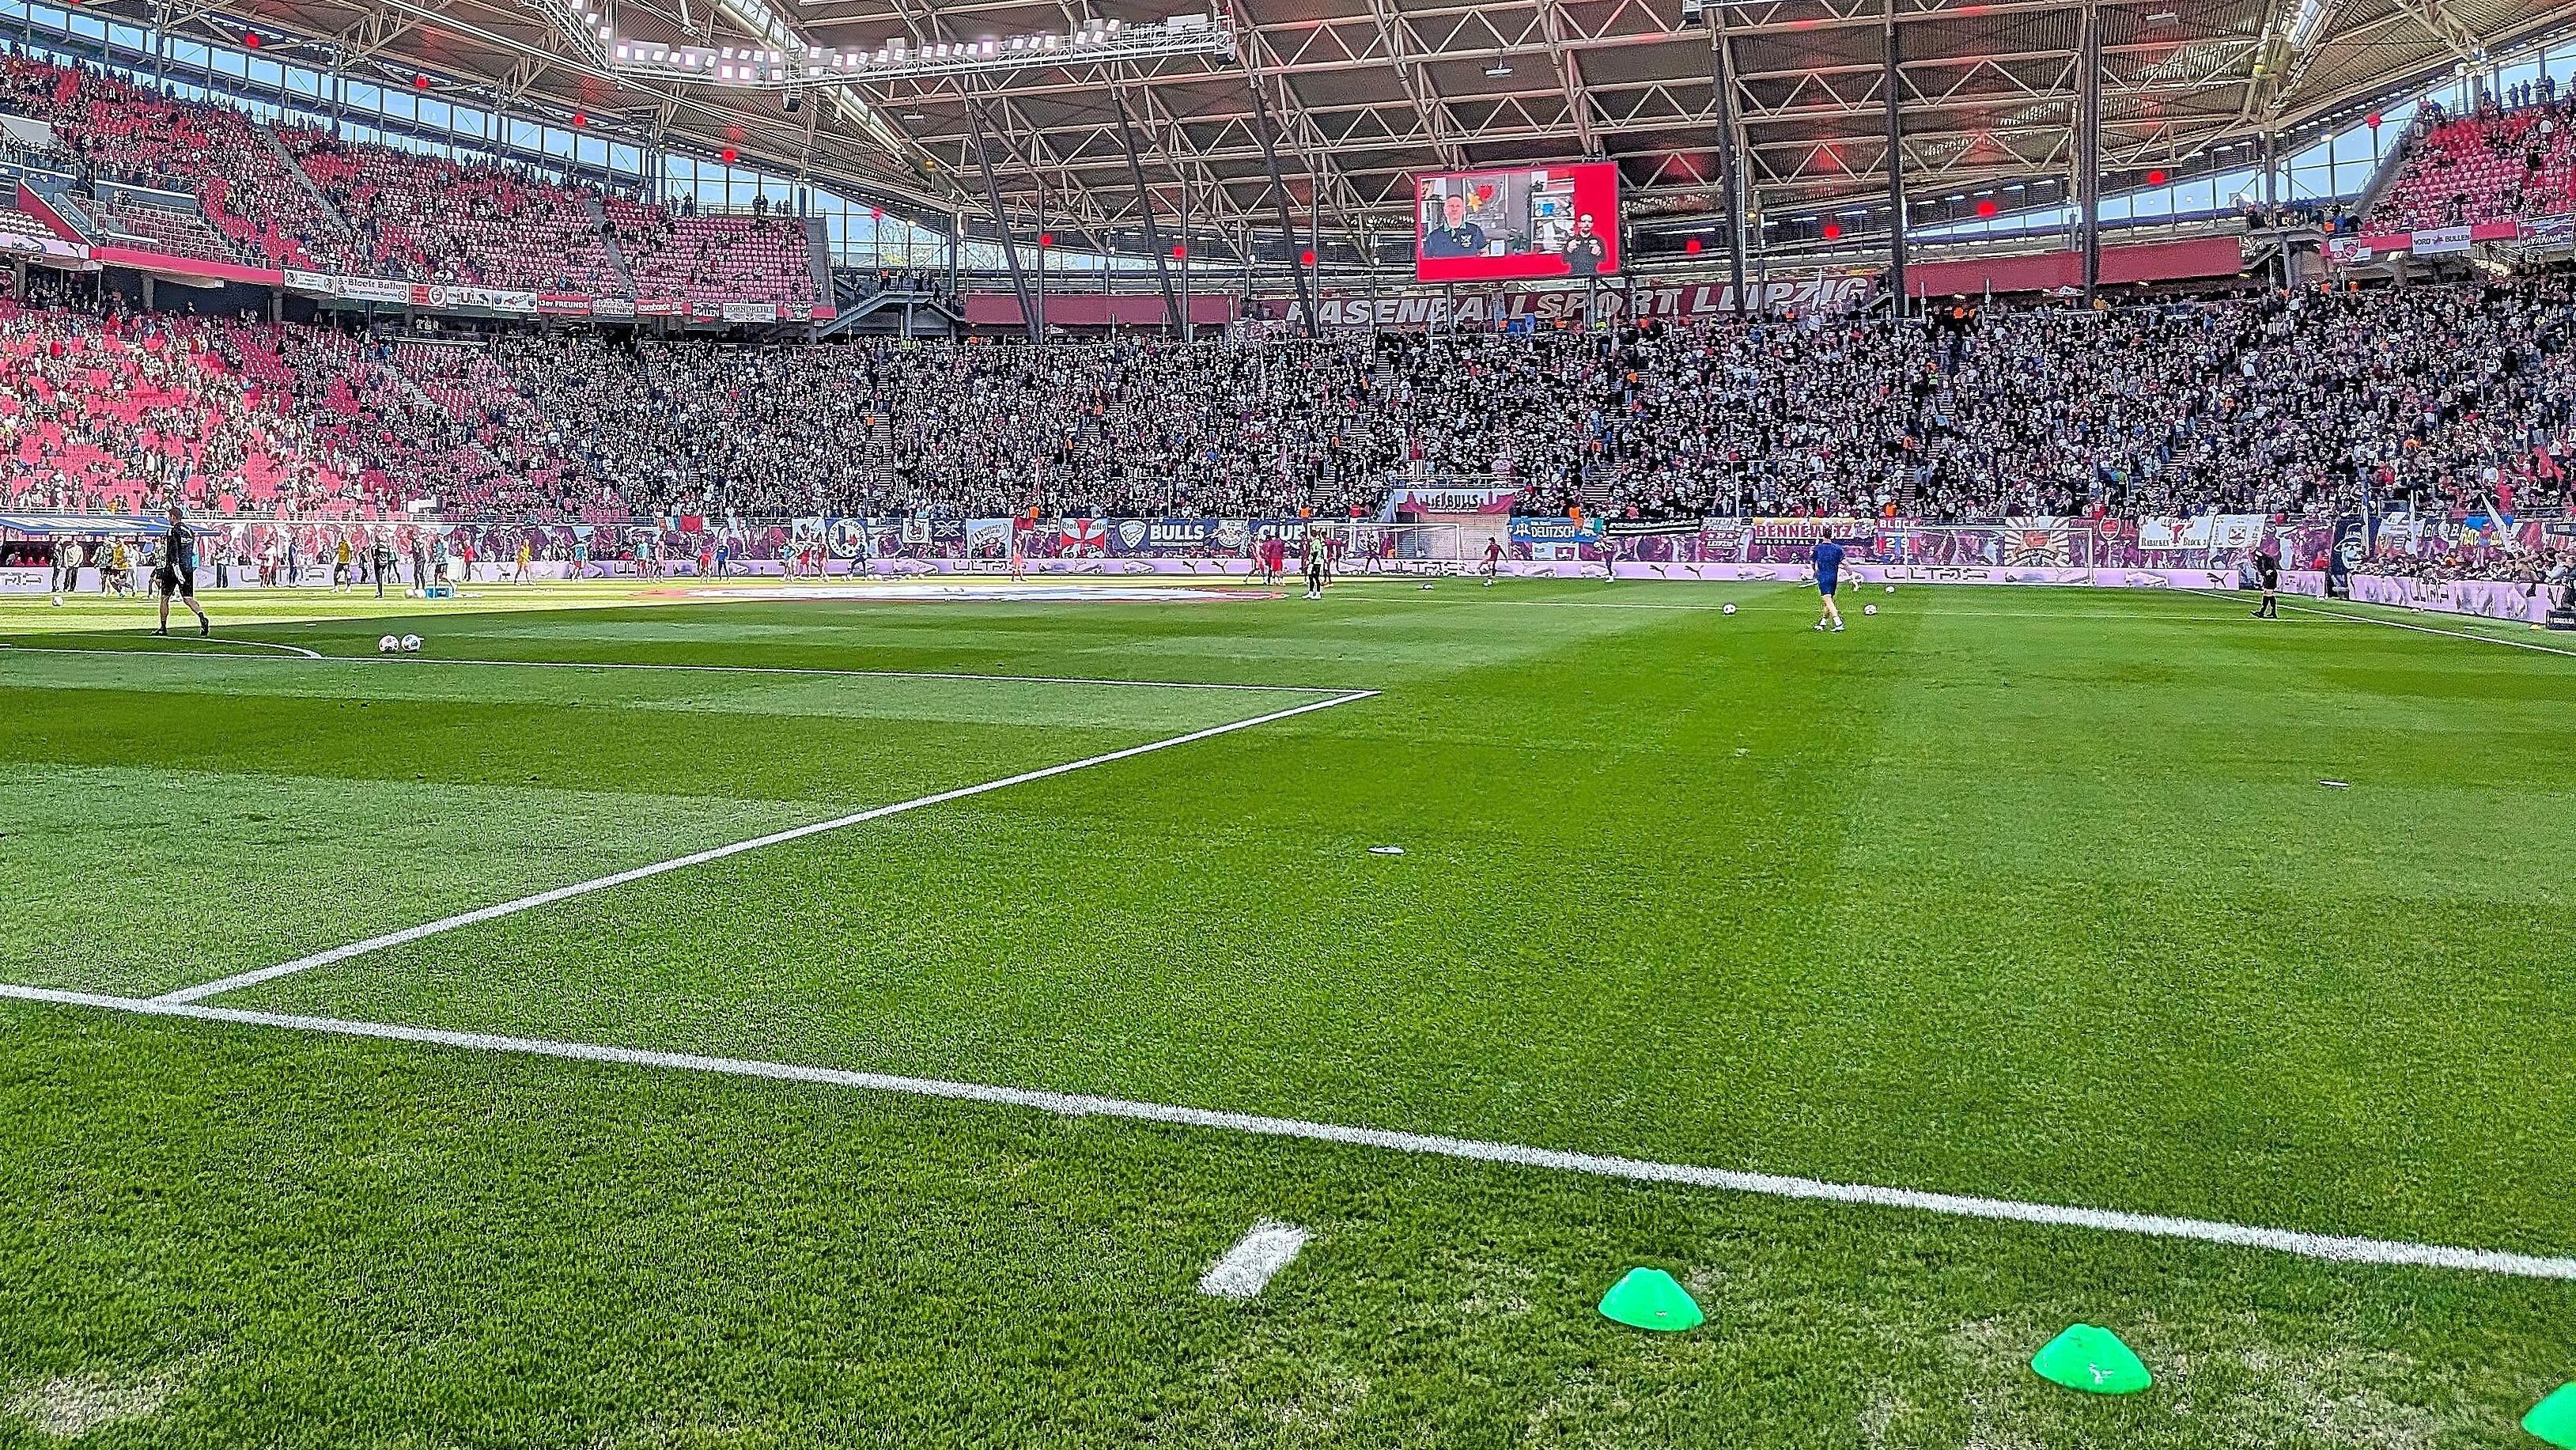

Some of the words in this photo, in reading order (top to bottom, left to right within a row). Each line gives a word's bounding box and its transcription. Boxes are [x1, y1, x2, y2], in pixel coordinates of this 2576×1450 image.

[554, 301, 589, 309] FREUNDE
[1879, 519, 1917, 528] BLOCK
[1150, 524, 1205, 540] BULLS
[1531, 525, 1575, 538] DELITZSCH
